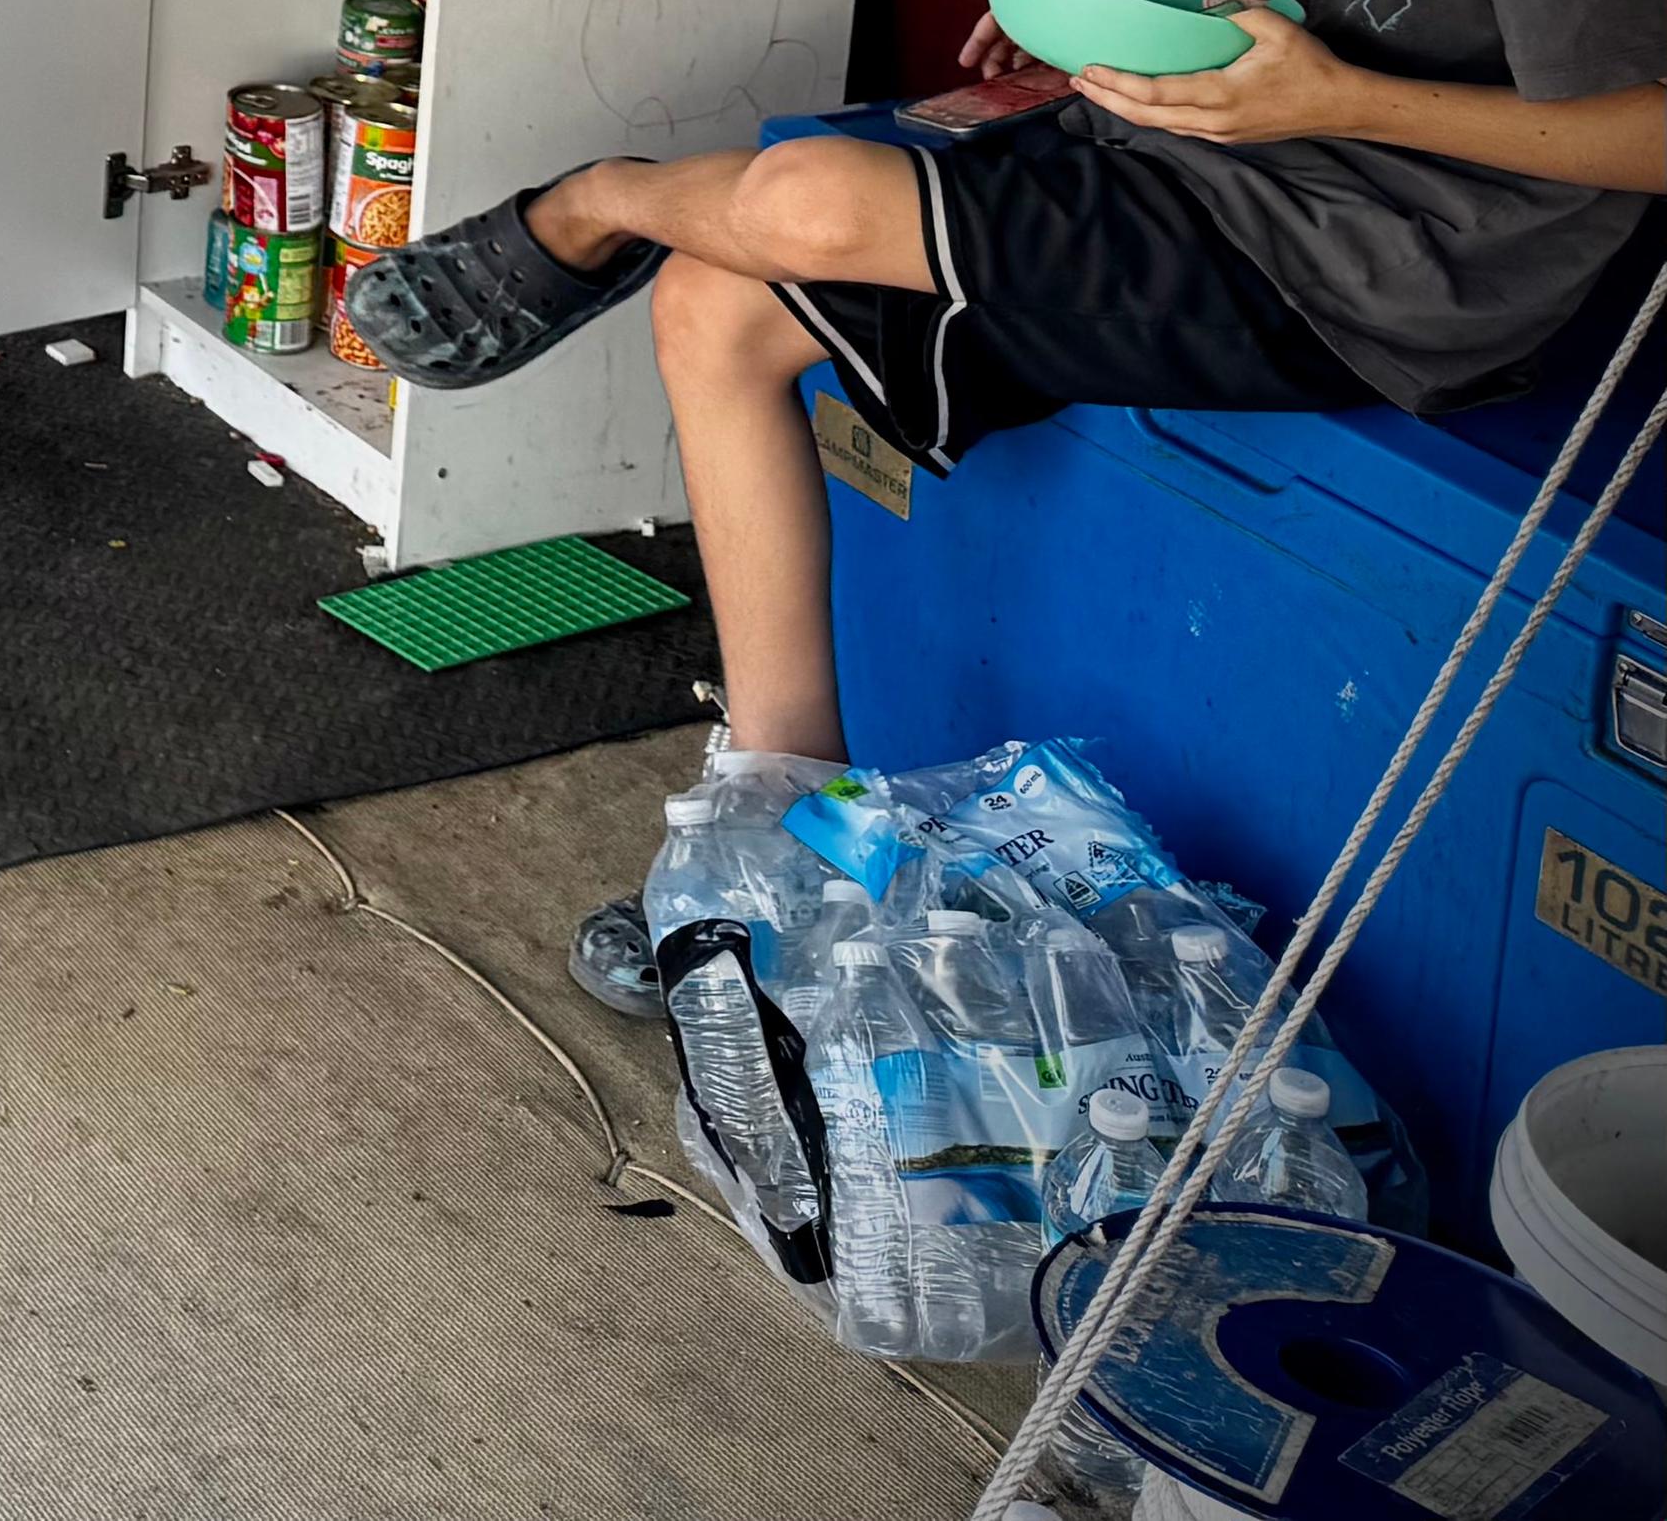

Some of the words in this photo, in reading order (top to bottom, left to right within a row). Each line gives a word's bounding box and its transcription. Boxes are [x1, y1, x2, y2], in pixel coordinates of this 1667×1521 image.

[984, 795, 1008, 809] 24
[995, 828, 1055, 867] TER
[1380, 1407, 1452, 1461] Polyester
